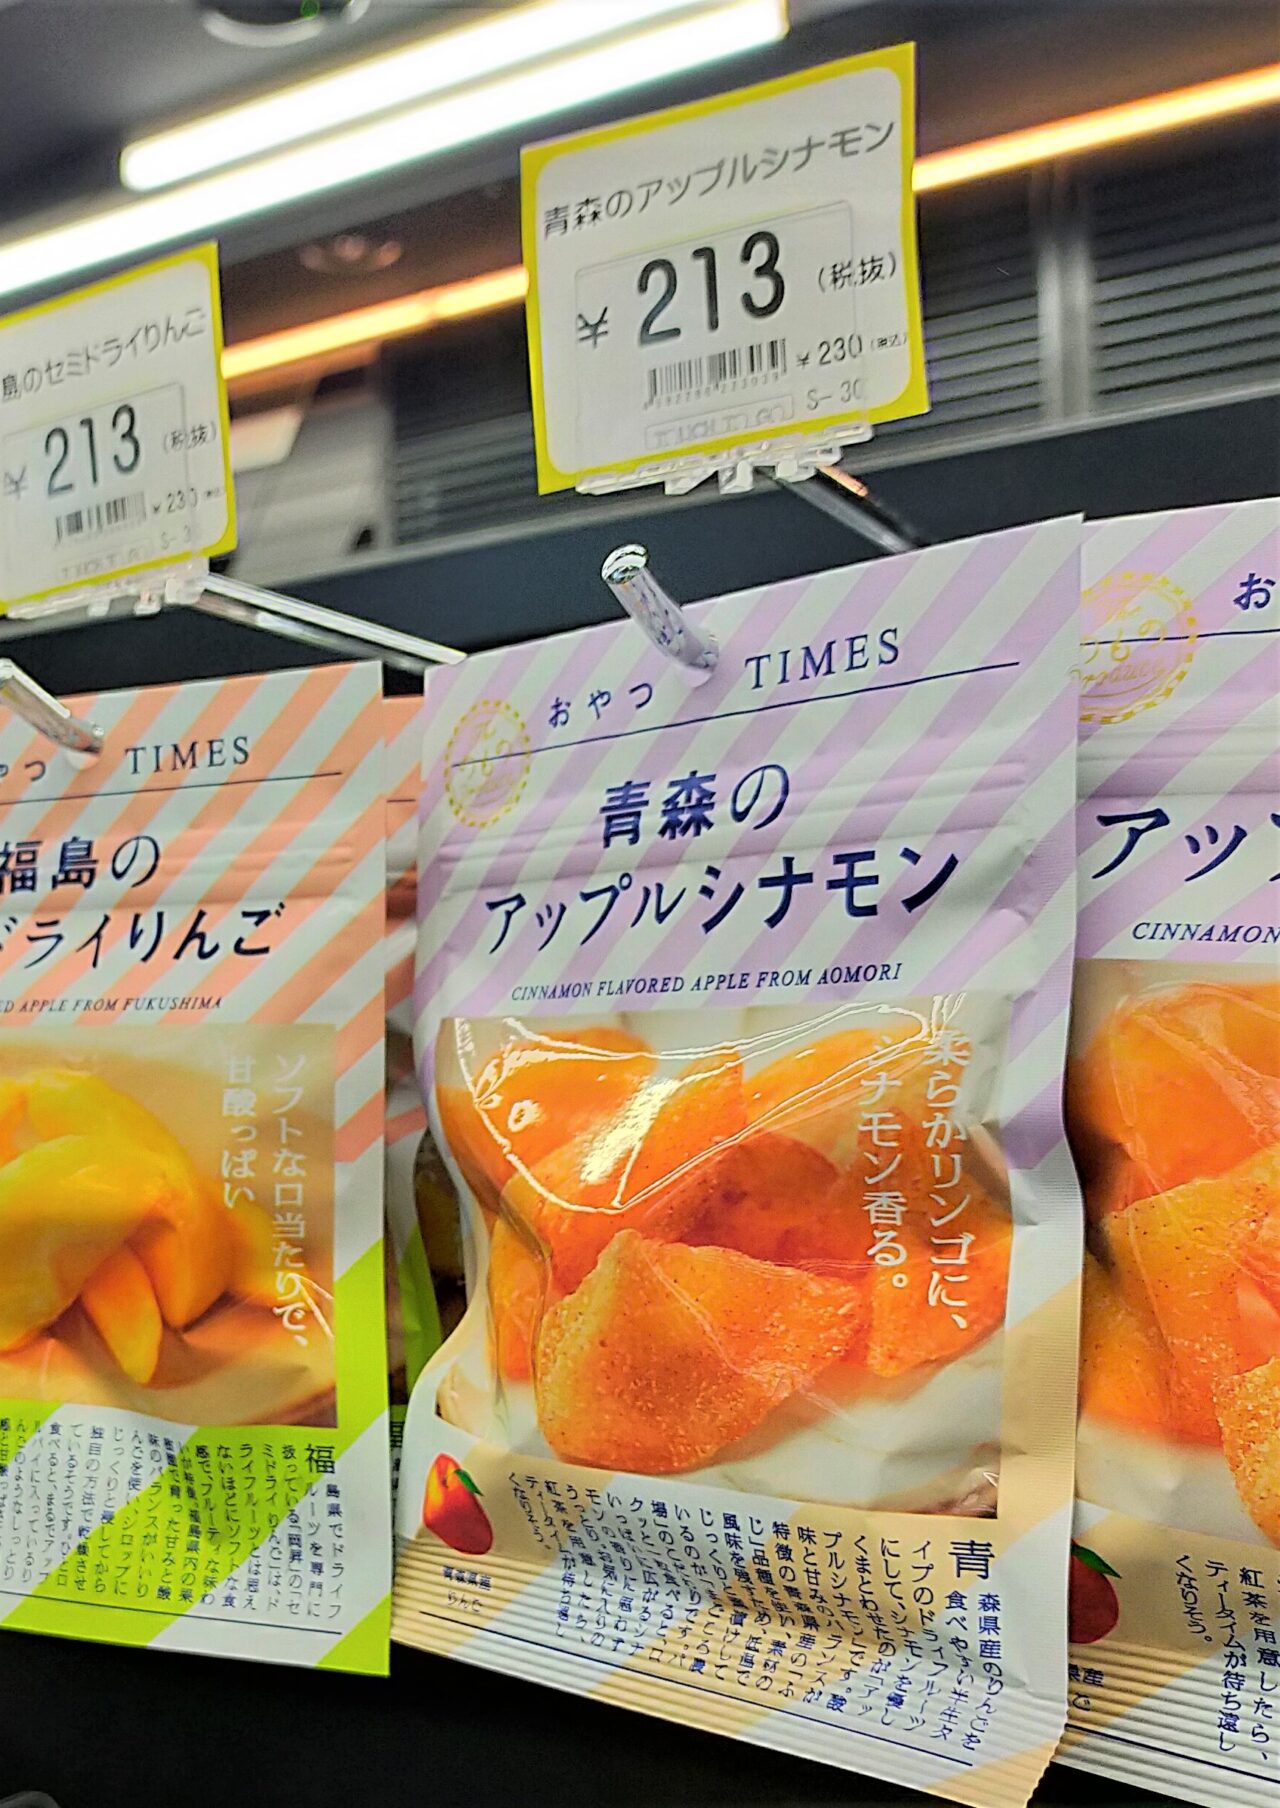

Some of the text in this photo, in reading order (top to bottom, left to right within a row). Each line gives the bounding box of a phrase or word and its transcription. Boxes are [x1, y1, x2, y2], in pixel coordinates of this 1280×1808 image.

[543, 121, 896, 240] 青森のアップルシナモン
[637, 230, 787, 347] 213
[817, 332, 863, 366] 230
[44, 402, 143, 497] 213
[548, 627, 901, 728] おやつ TIMES
[124, 736, 252, 776] TIMES
[599, 763, 791, 849] 青森の
[1091, 807, 1280, 882] アッ
[486, 845, 960, 955] アップルシナモン
[18, 998, 68, 1013] APPLE
[72, 997, 121, 1012] FROM
[122, 995, 224, 1012] FUKUSHIMA
[512, 962, 904, 1001] CINNAMON FLAVORED APPLE FROM AOMORI
[221, 1055, 257, 1209] 甘酸っぱい
[922, 1029, 975, 1329] 柔らかリンゴに、
[272, 1054, 309, 1347] ソフトな口当たりで、
[1175, 1554, 1213, 1642] くなりそう。
[1205, 1559, 1248, 1752] ティータイムが待ち遠し
